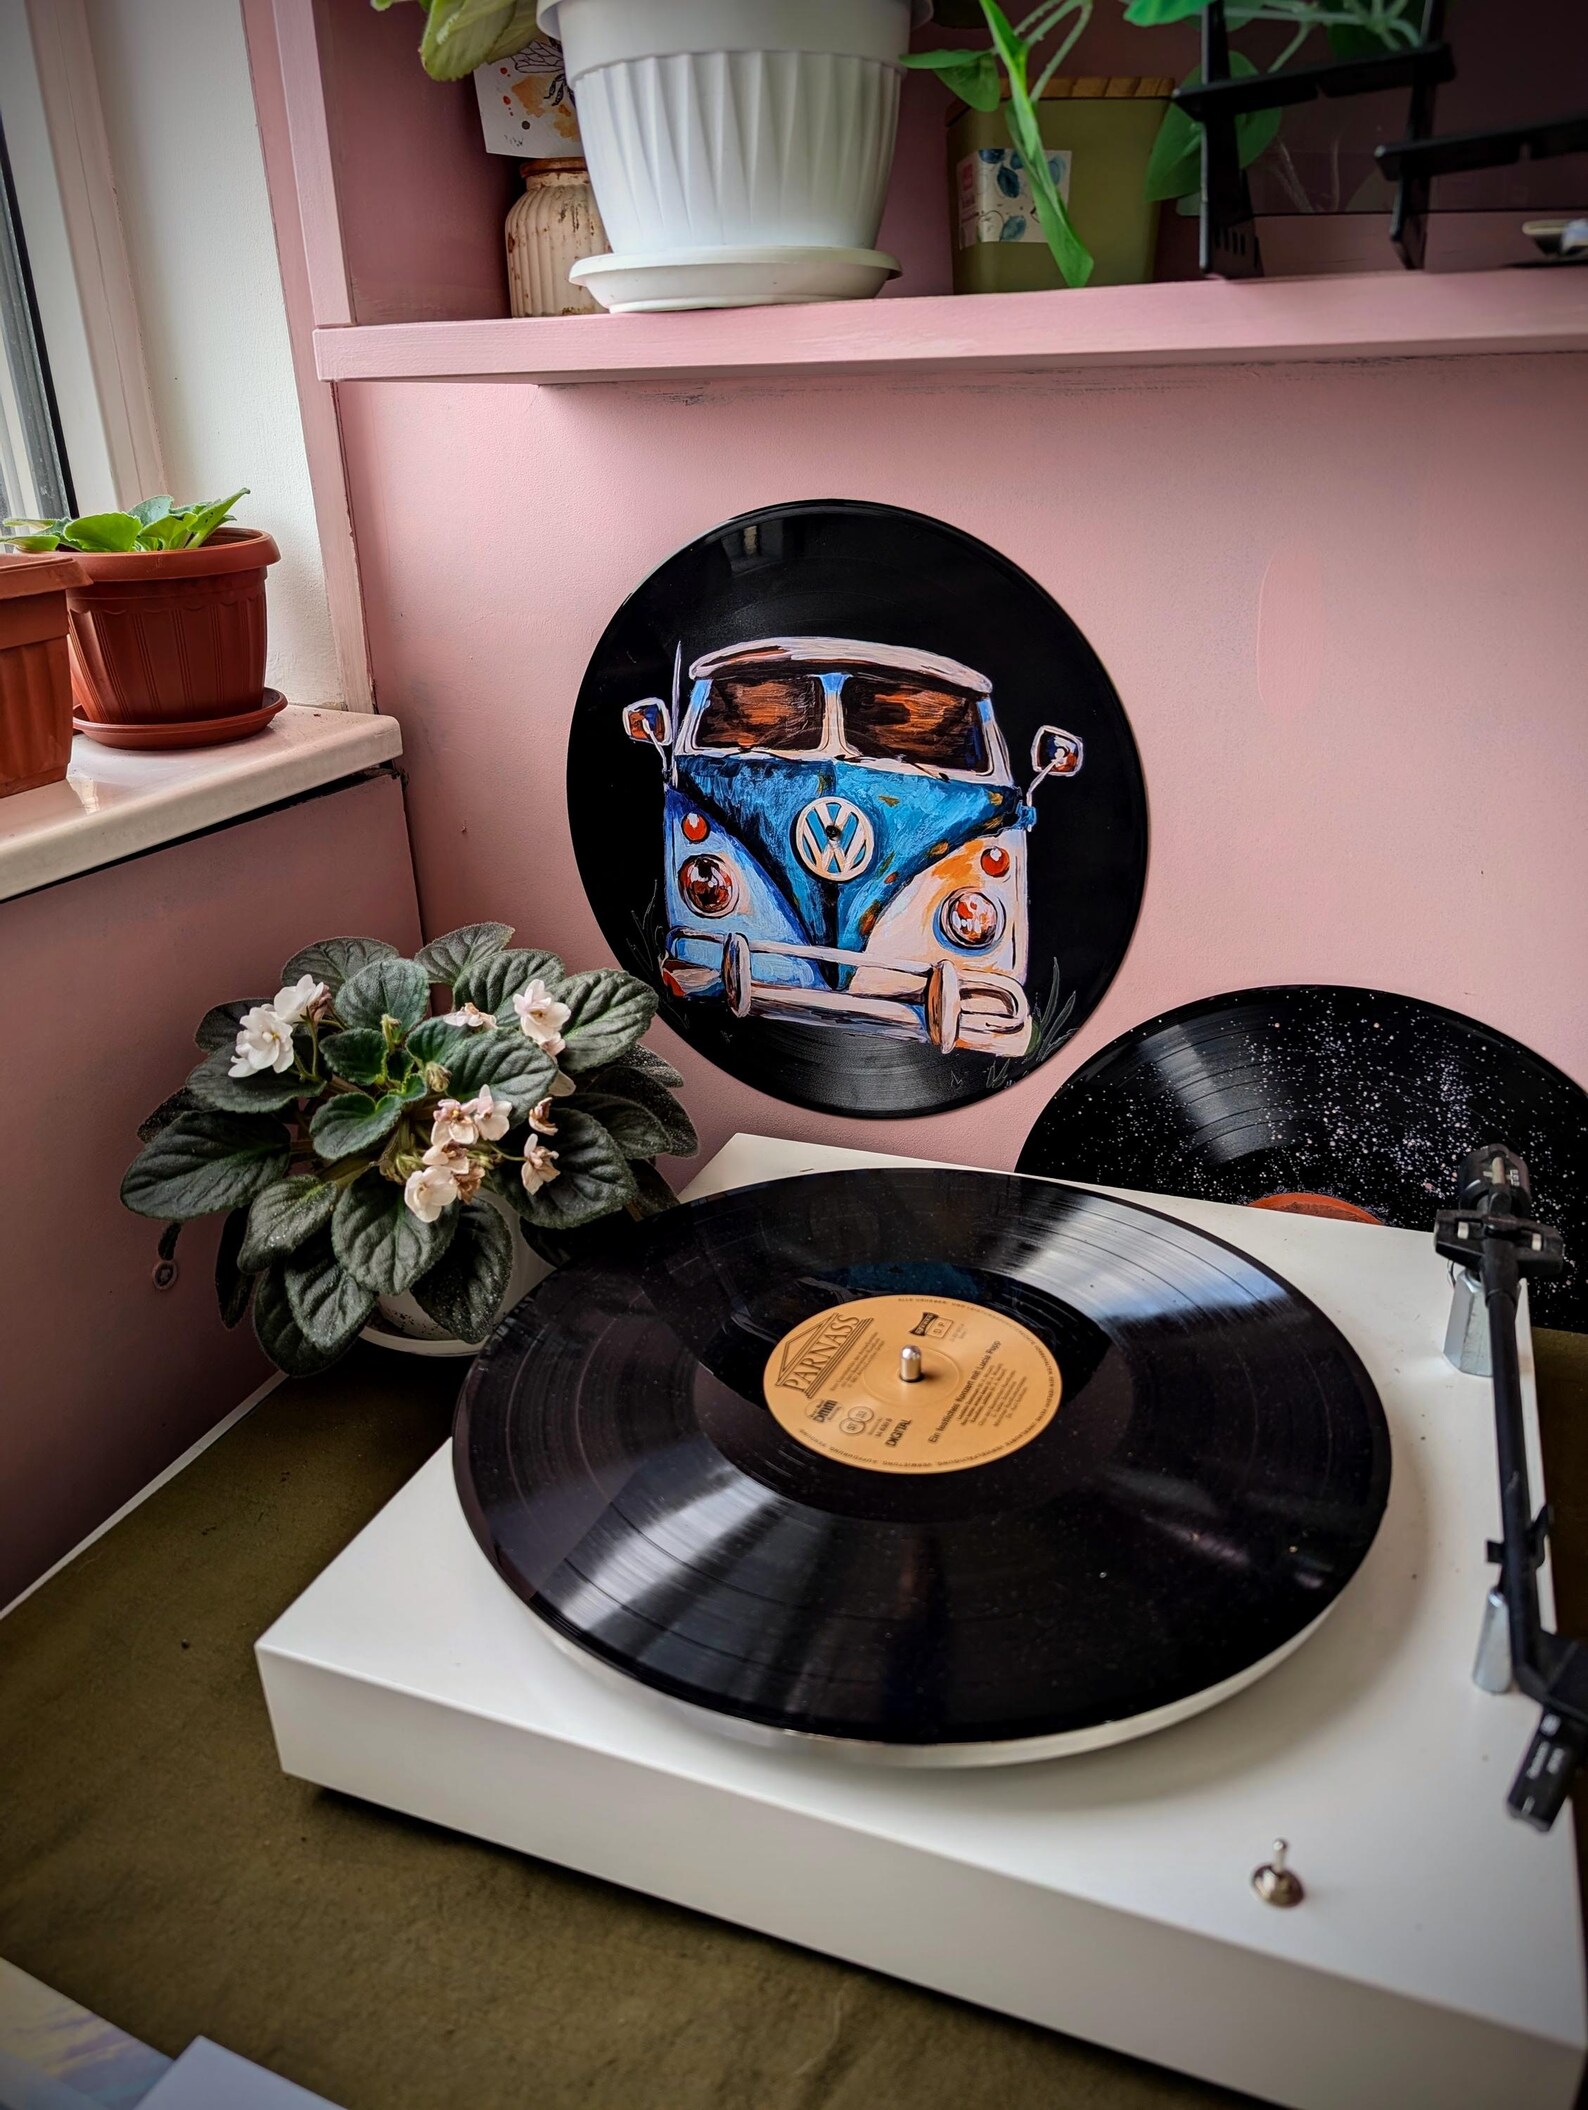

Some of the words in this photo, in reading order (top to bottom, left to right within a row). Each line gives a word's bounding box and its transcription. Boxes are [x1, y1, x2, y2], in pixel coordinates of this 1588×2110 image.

[798, 799, 871, 878] VW
[782, 1313, 861, 1393] PARNASS
[927, 1432, 942, 1443] Ein
[935, 1402, 961, 1432] festliches
[954, 1380, 974, 1403] Konzert
[970, 1369, 982, 1380] mit
[978, 1354, 992, 1370] Lucia
[987, 1339, 1002, 1355] Popp
[884, 1418, 913, 1447] DIGITAL
